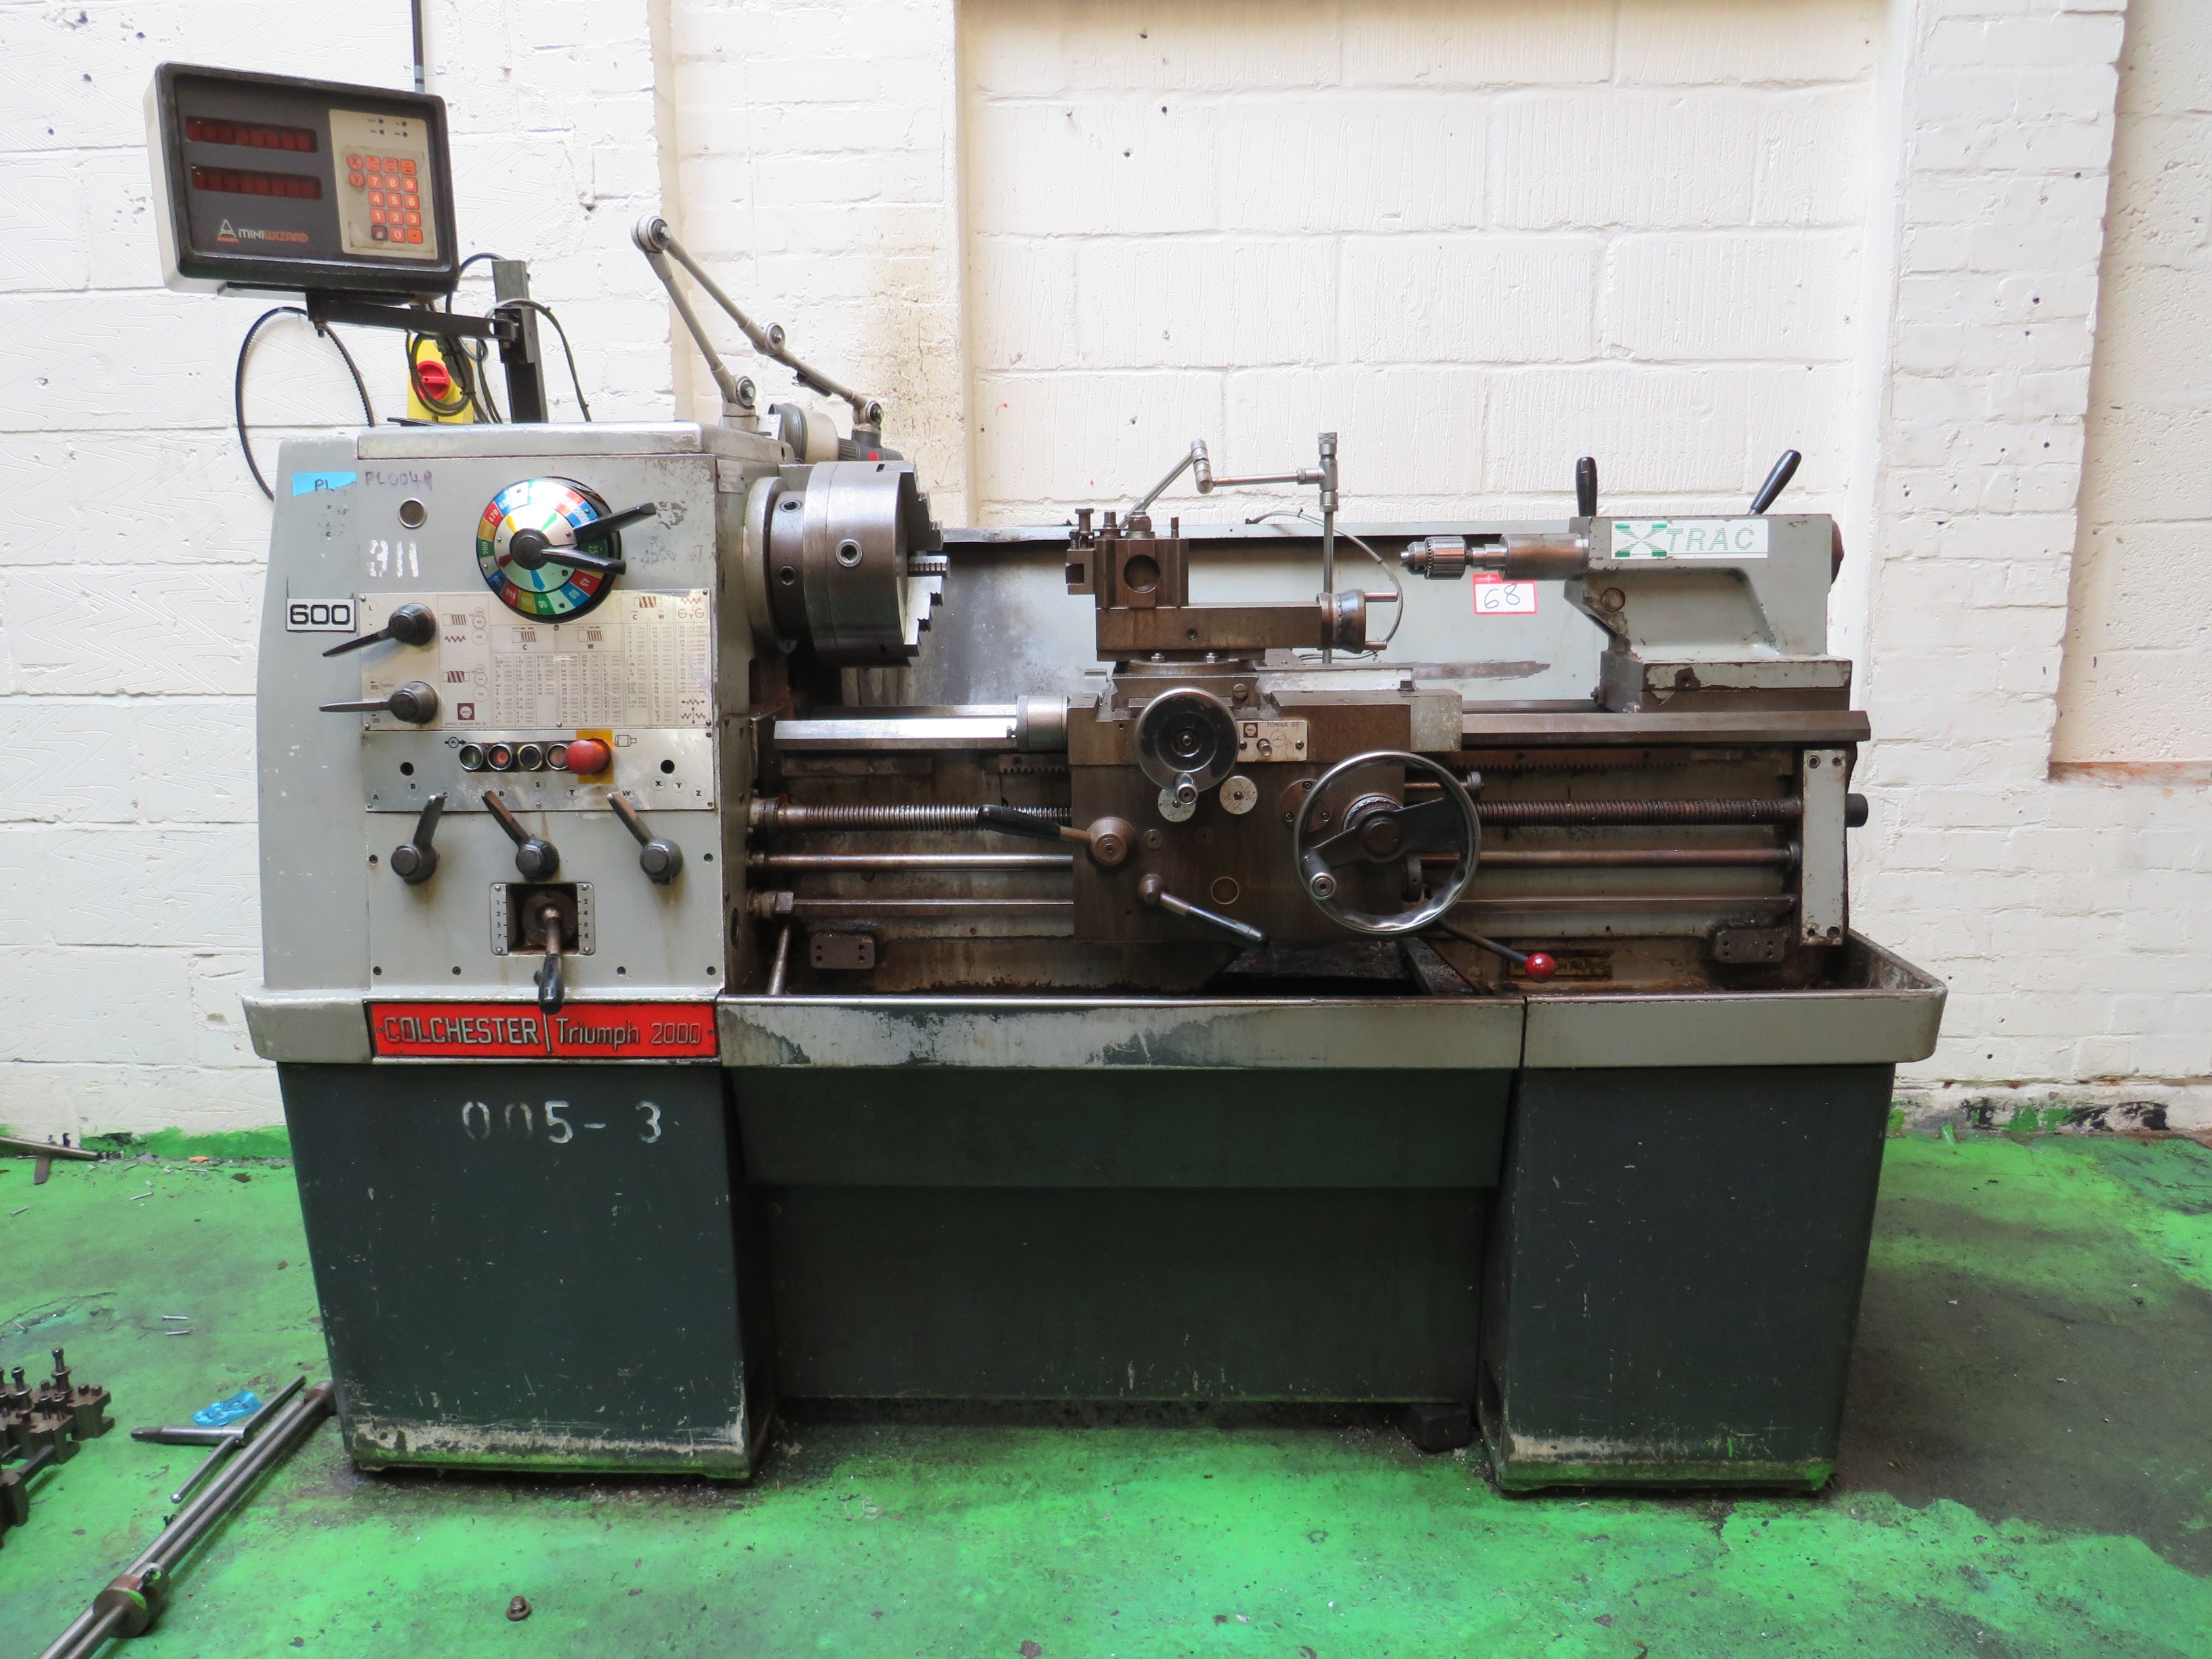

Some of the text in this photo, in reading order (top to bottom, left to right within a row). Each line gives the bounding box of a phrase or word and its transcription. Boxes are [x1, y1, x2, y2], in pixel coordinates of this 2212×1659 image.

[372, 178, 378, 186] 7
[390, 179, 396, 187] 8
[407, 180, 413, 188] 9
[409, 198, 415, 206] 6
[375, 212, 417, 223] 1 2 3
[394, 231, 401, 239] 0
[489, 510, 499, 523] 470
[573, 507, 590, 523] 2000
[1614, 523, 1755, 558] XTRAC
[588, 545, 599, 554] 25
[579, 577, 591, 588] 45
[1483, 583, 1521, 609] 68
[290, 604, 350, 626] 600
[384, 1017, 701, 1050] COLCHESTER Triumph 2000
